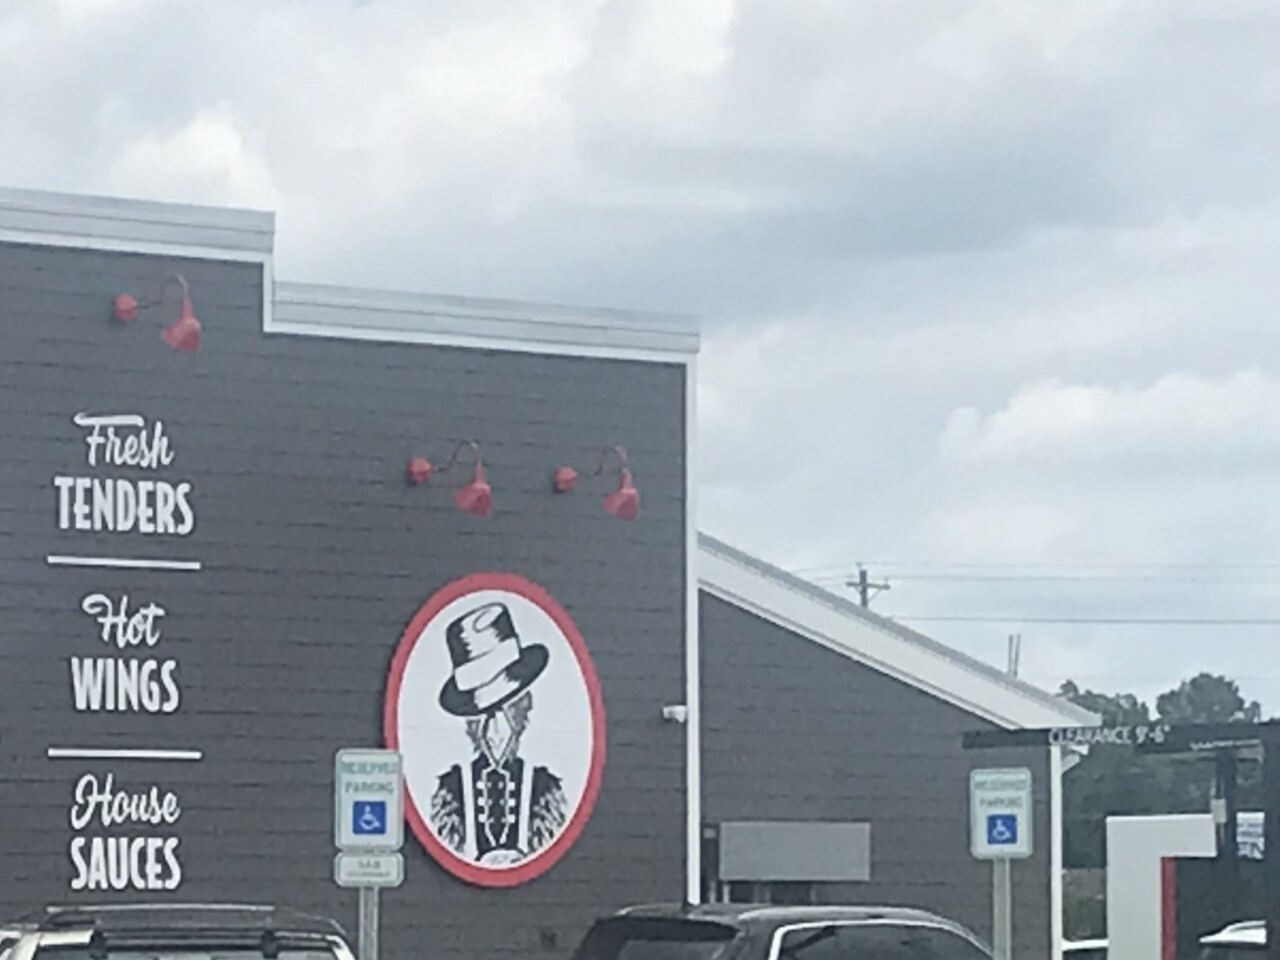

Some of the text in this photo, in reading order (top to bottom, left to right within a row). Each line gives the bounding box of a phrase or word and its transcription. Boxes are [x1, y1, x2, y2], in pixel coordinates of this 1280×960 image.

[73, 412, 175, 469] Fresh
[54, 475, 194, 535] TENDERS
[82, 593, 166, 648] Hot
[71, 656, 180, 713] WINGS
[71, 773, 181, 830] House
[71, 836, 182, 890] SAUCES
